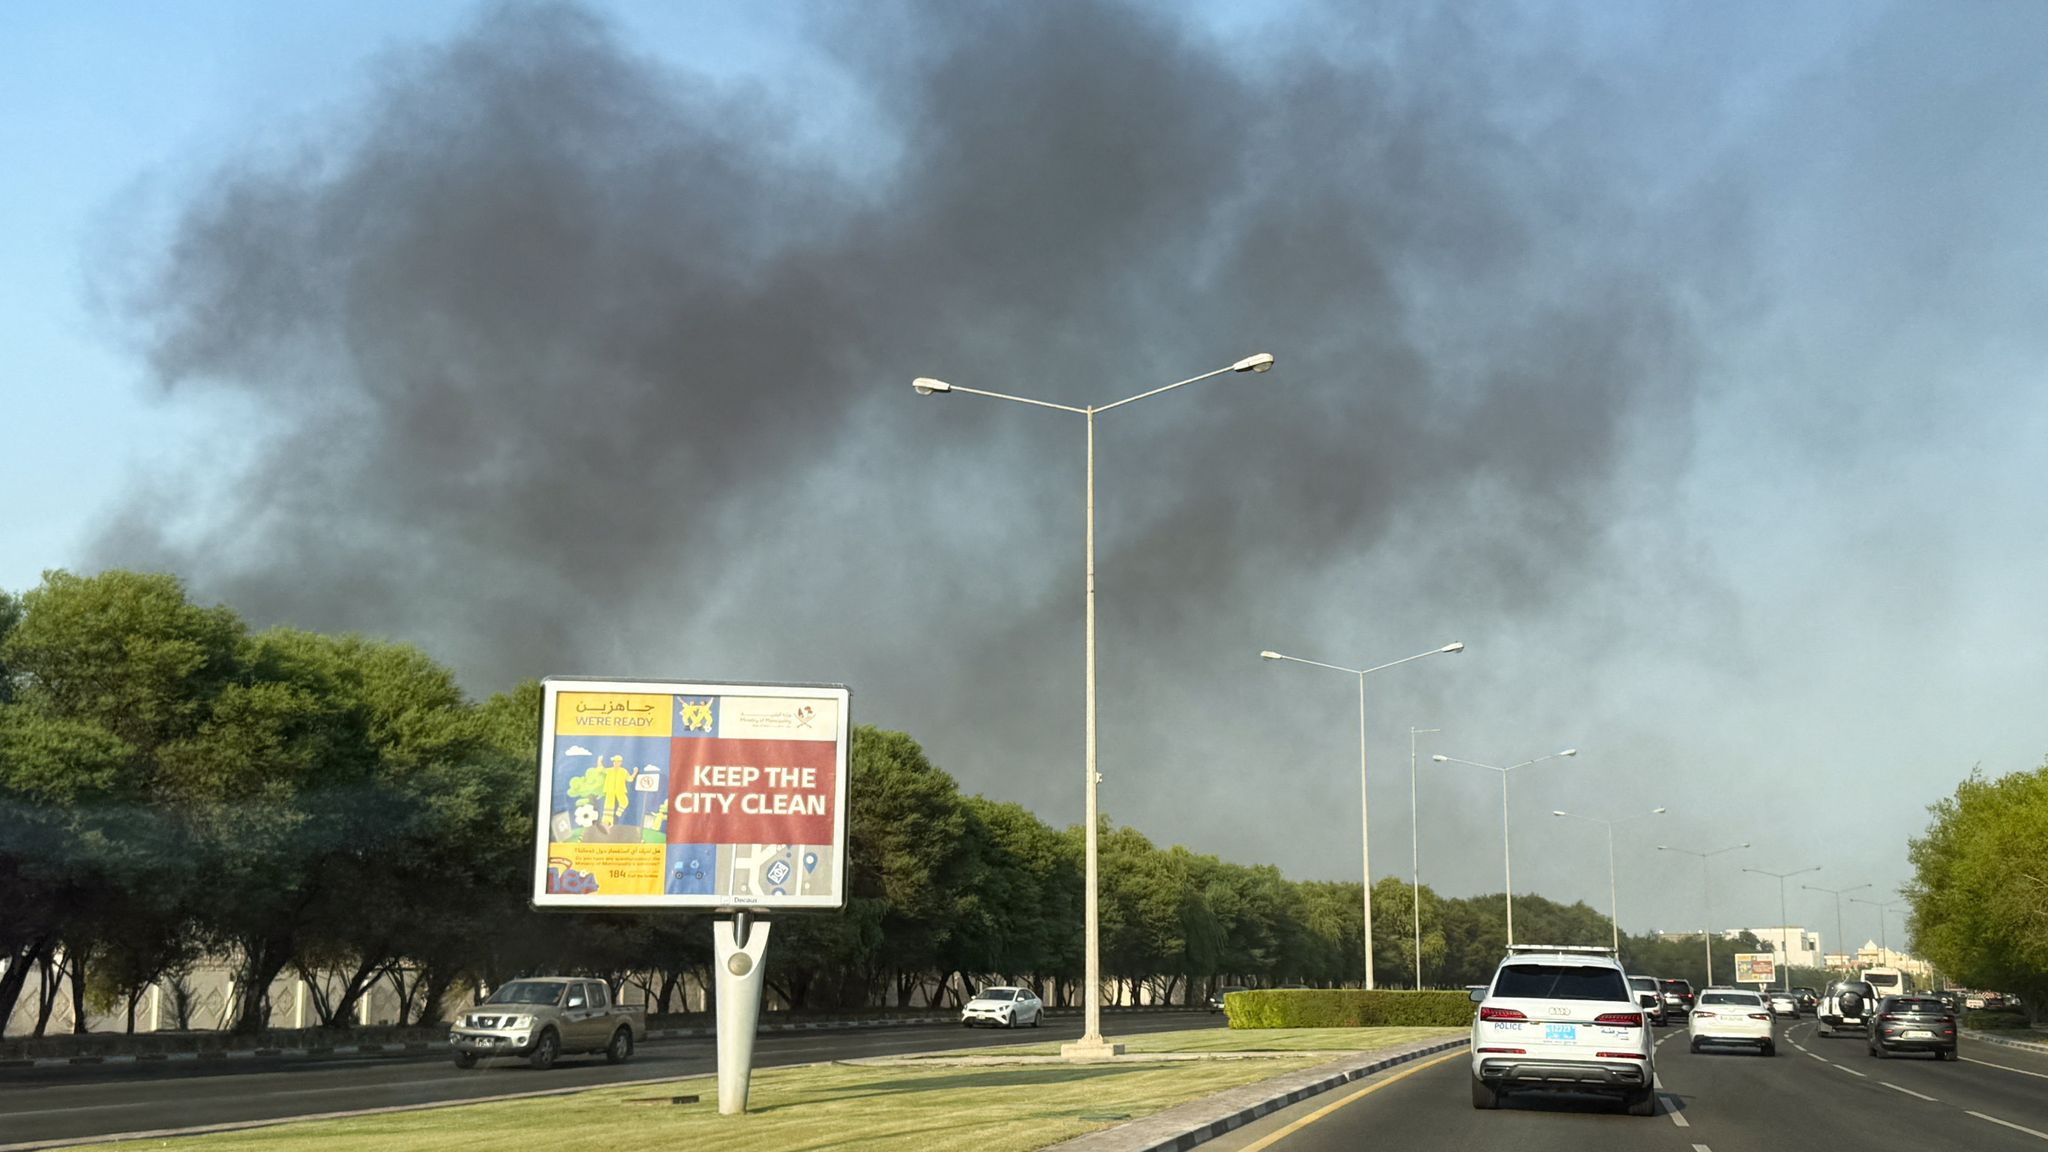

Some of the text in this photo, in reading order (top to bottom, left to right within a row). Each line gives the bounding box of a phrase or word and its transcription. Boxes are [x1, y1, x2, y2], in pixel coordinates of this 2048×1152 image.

[613, 717, 654, 727] READY
[693, 766, 816, 788] KEEP THE
[674, 792, 825, 815] CITY CLEAN
[609, 869, 626, 878] 184
[1494, 1022, 1523, 1031] POLICE
